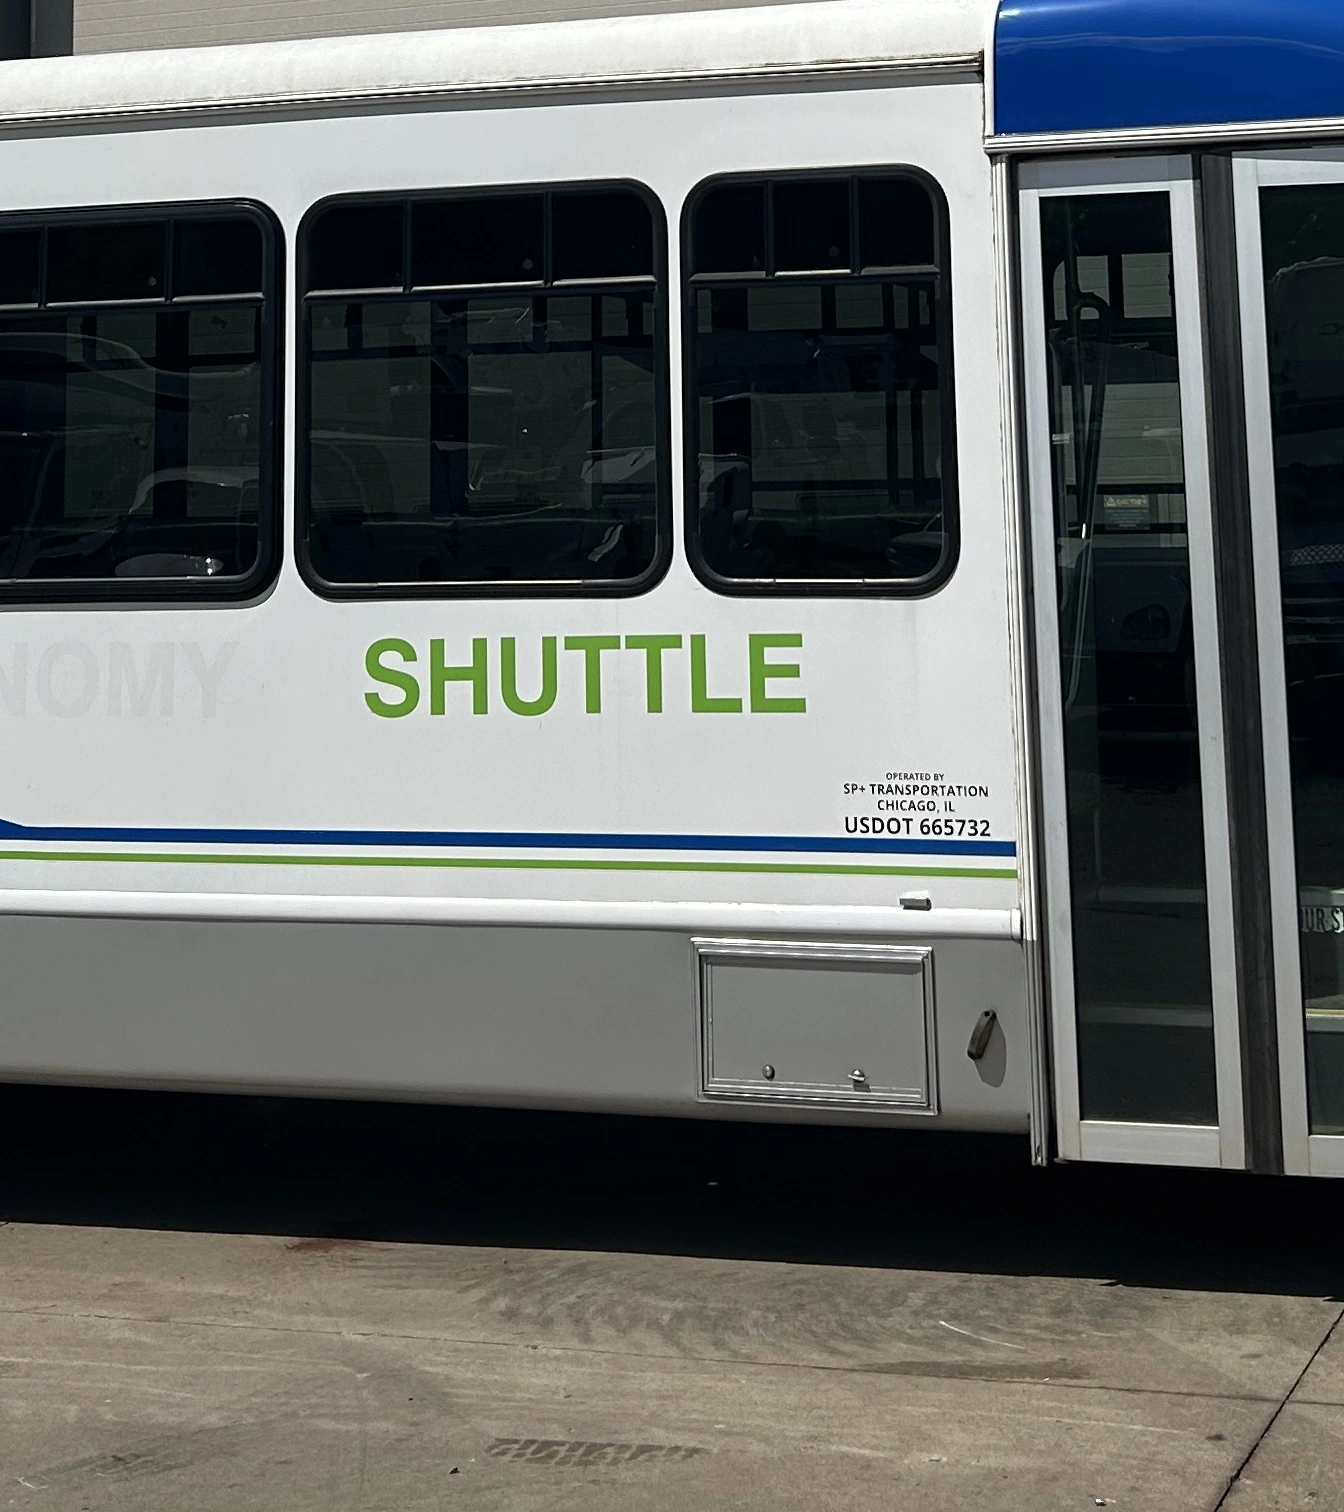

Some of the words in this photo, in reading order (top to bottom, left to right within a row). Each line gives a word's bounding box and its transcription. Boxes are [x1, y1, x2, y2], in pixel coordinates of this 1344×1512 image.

[362, 632, 806, 718] SHUTTLE
[886, 772, 931, 781] OPERATED
[933, 773, 945, 781] BY
[843, 783, 866, 795] SP+
[869, 784, 989, 797] TRANSPORTATION
[877, 799, 940, 814] CHICAGO,
[944, 801, 955, 813] IL
[845, 816, 914, 834] USDOT
[919, 818, 991, 837] 665732
